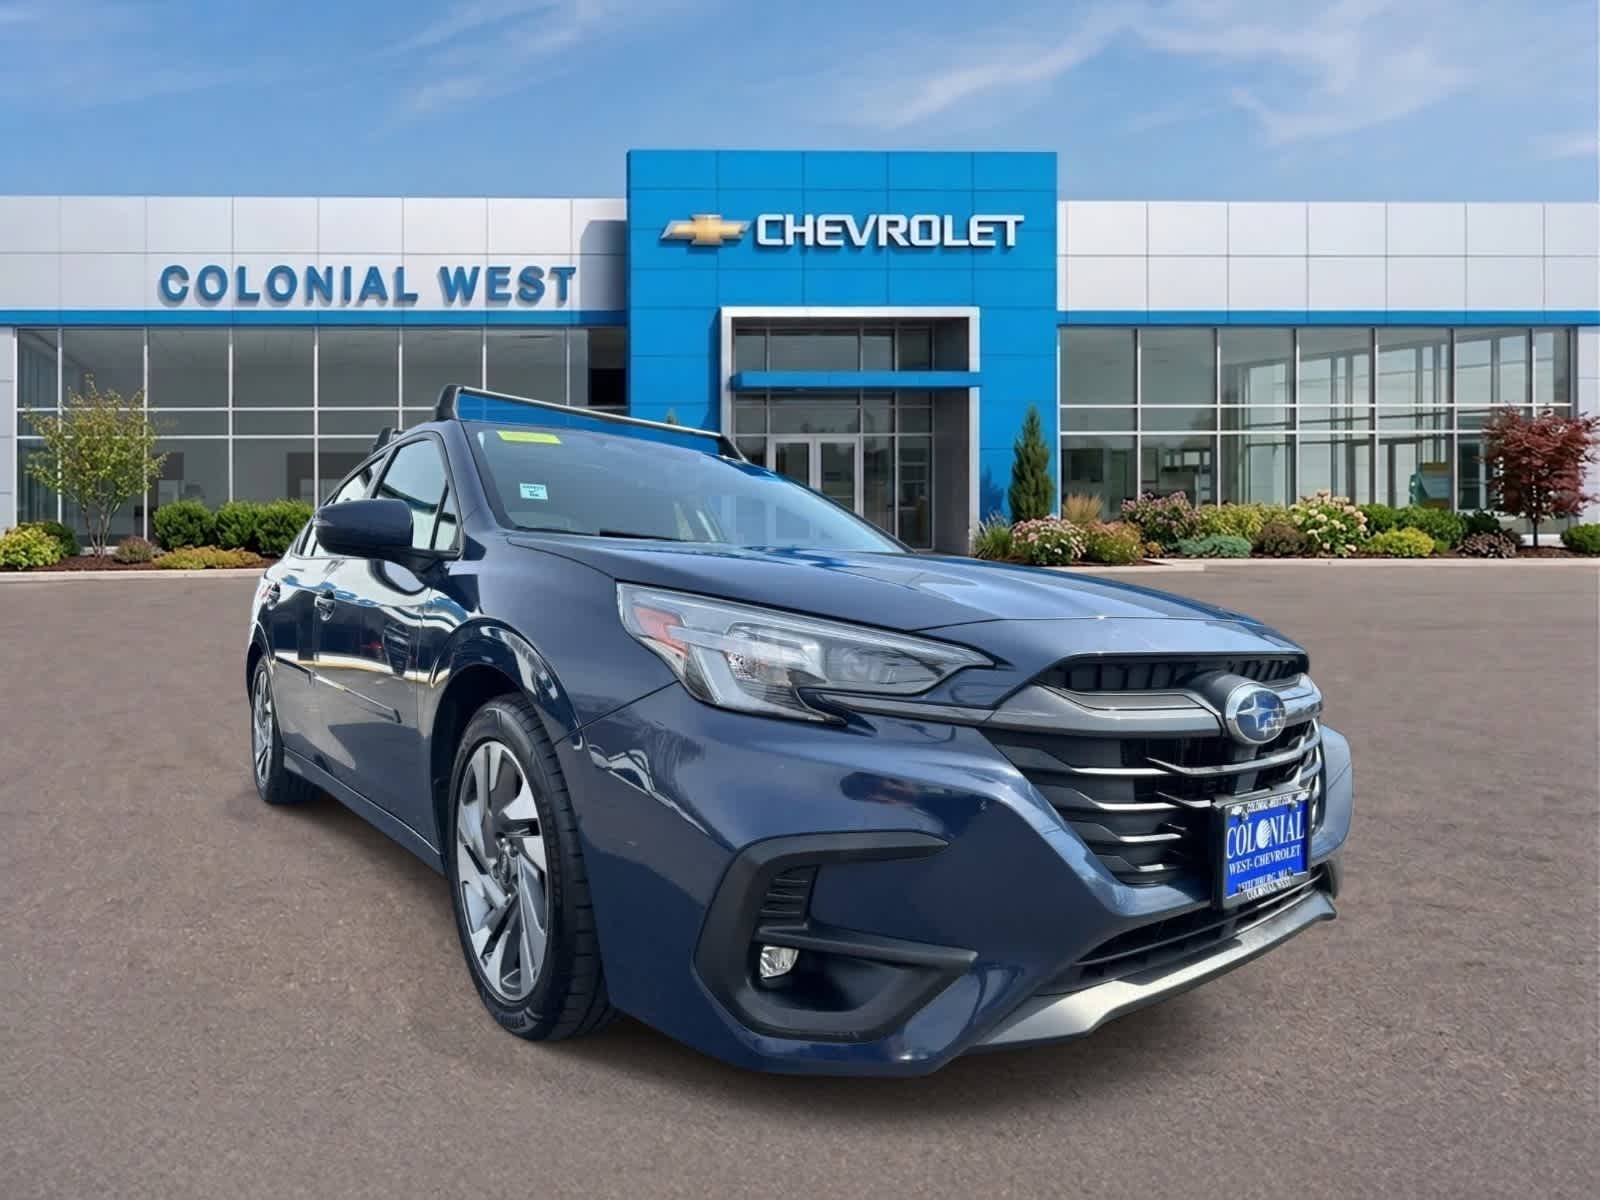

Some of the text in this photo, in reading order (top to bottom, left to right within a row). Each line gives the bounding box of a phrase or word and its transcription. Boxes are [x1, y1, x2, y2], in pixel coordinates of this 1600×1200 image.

[756, 213, 1025, 248] CHEVROLET
[160, 264, 577, 304] COLONIAL WEST
[1226, 811, 1305, 859] COLONIAL
